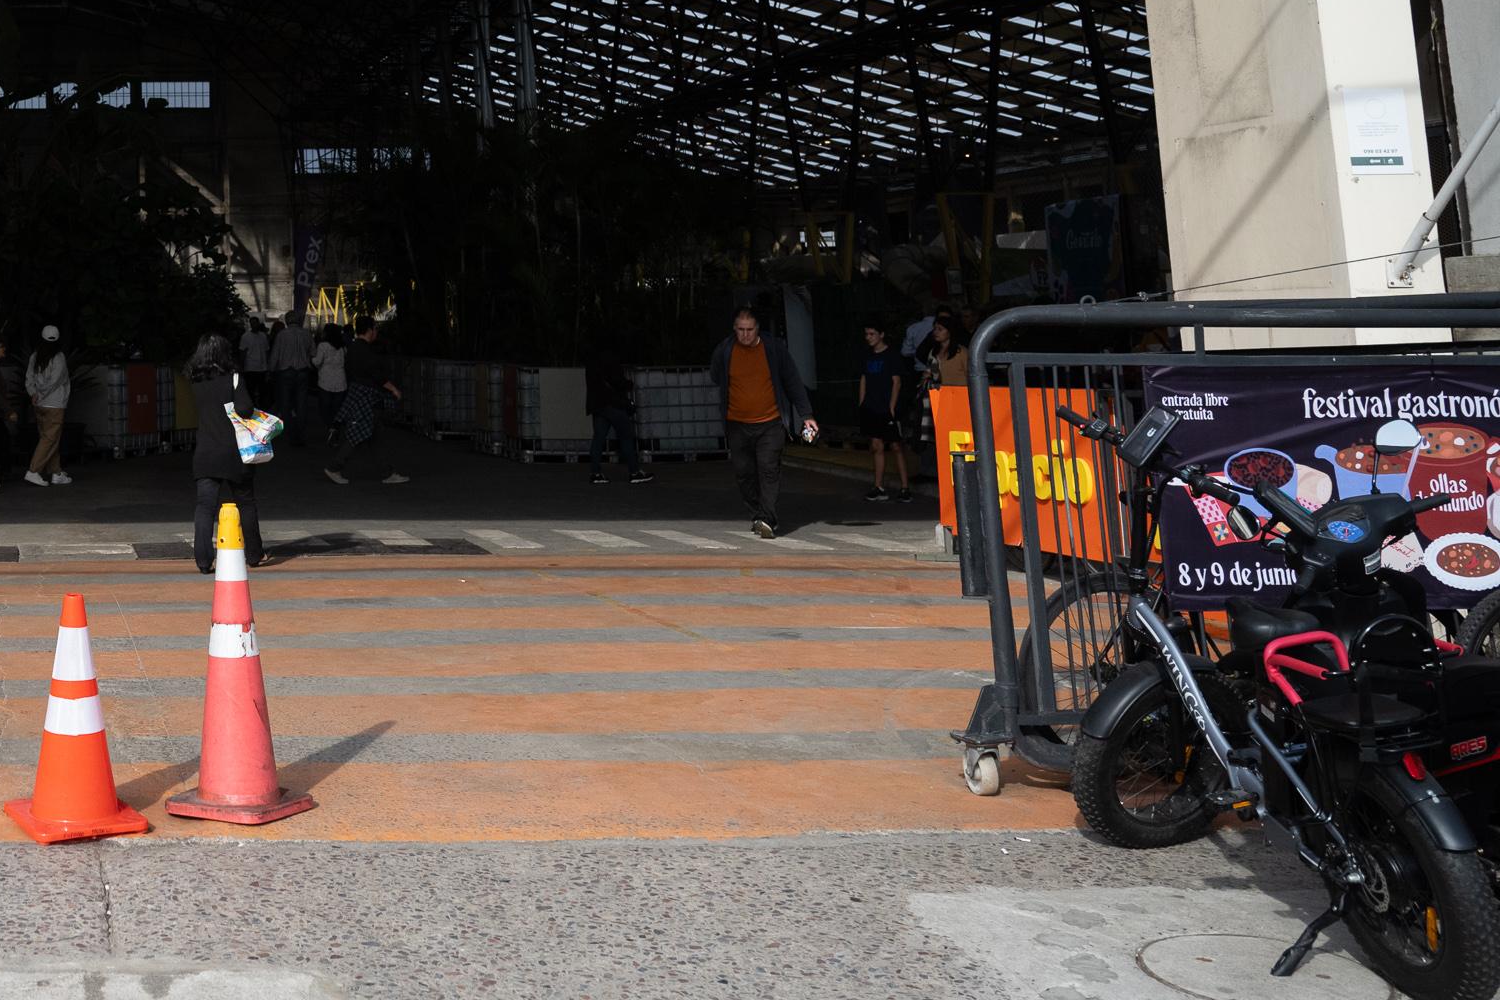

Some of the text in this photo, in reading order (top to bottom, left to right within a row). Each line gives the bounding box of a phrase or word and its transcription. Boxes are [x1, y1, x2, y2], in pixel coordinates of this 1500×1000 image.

[297, 234, 323, 287] Prex
[1161, 392, 1230, 407] entrada libre
[1302, 388, 1393, 419] festival
[1175, 406, 1214, 421] ratuita
[1429, 472, 1468, 494] ollas
[1178, 562, 1192, 587] 8
[1194, 567, 1207, 592] y
[1210, 561, 1225, 586] 9
[1229, 560, 1253, 587] de
[1450, 735, 1488, 761] ARES
